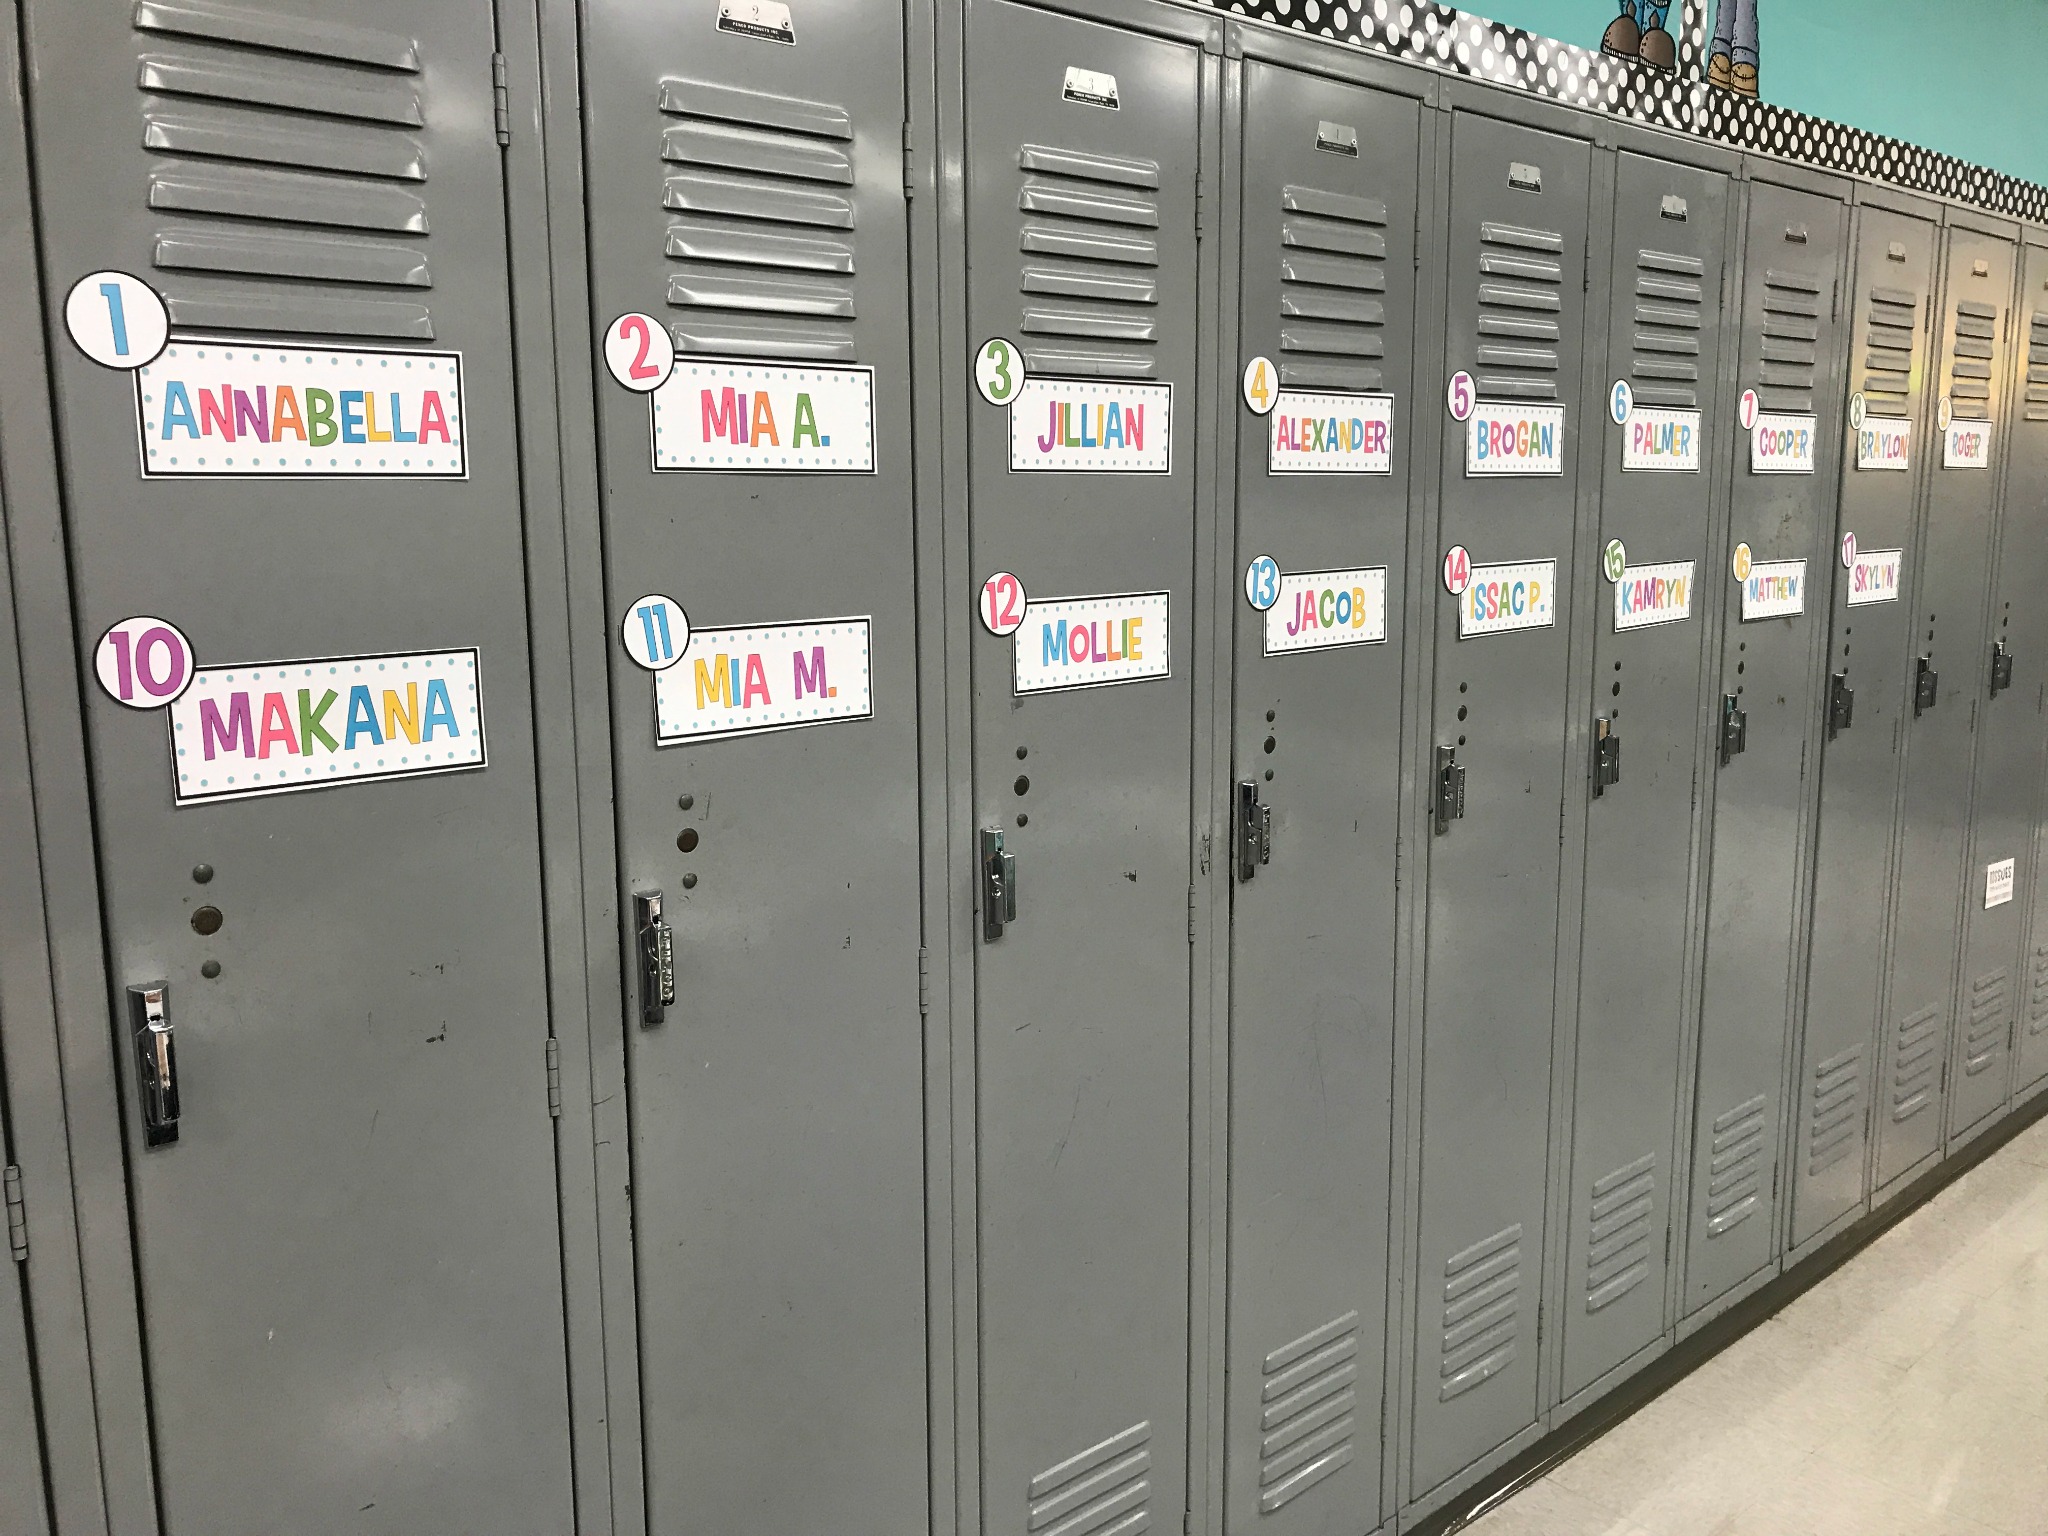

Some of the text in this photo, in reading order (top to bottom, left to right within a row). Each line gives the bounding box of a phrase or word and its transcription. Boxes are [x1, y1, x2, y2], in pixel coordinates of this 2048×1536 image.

[100, 283, 129, 355] 1
[620, 316, 659, 380] 2
[987, 341, 1012, 399] 3
[1251, 362, 1268, 408] 4
[162, 380, 451, 446] ANNABELLA
[1455, 376, 1468, 417] 5
[1616, 384, 1626, 420] 6
[1744, 393, 1753, 427] 7
[1853, 395, 1862, 429] 8
[1941, 399, 1949, 428] 9
[701, 387, 830, 448] MIA A.
[1038, 401, 1144, 452] JILLIAN
[1276, 415, 1386, 454] ALEXANDER
[1478, 420, 1552, 459] BROGAN
[1634, 422, 1690, 457] PALMER
[1760, 428, 1807, 458] COOPER
[1859, 431, 1908, 460] BRAYLON
[1952, 431, 1982, 459] ROGER
[1446, 549, 1467, 590] 14
[1605, 541, 1624, 579] 15
[1735, 547, 1751, 581] 16
[1844, 534, 1854, 566] 17
[1252, 559, 1275, 606] 13
[1622, 575, 1687, 615] KAMRYN
[1750, 576, 1798, 602] MATTHEW
[1855, 563, 1895, 593] SKYLYN
[985, 575, 1020, 629] 12
[1287, 587, 1365, 636] JACOB
[1470, 581, 1545, 620] ISSAC P.
[638, 604, 672, 662] 11
[1043, 617, 1142, 666] MOLLIE
[109, 627, 185, 700] 10
[694, 647, 837, 709] MIA M.
[200, 679, 459, 760] MAKANA
